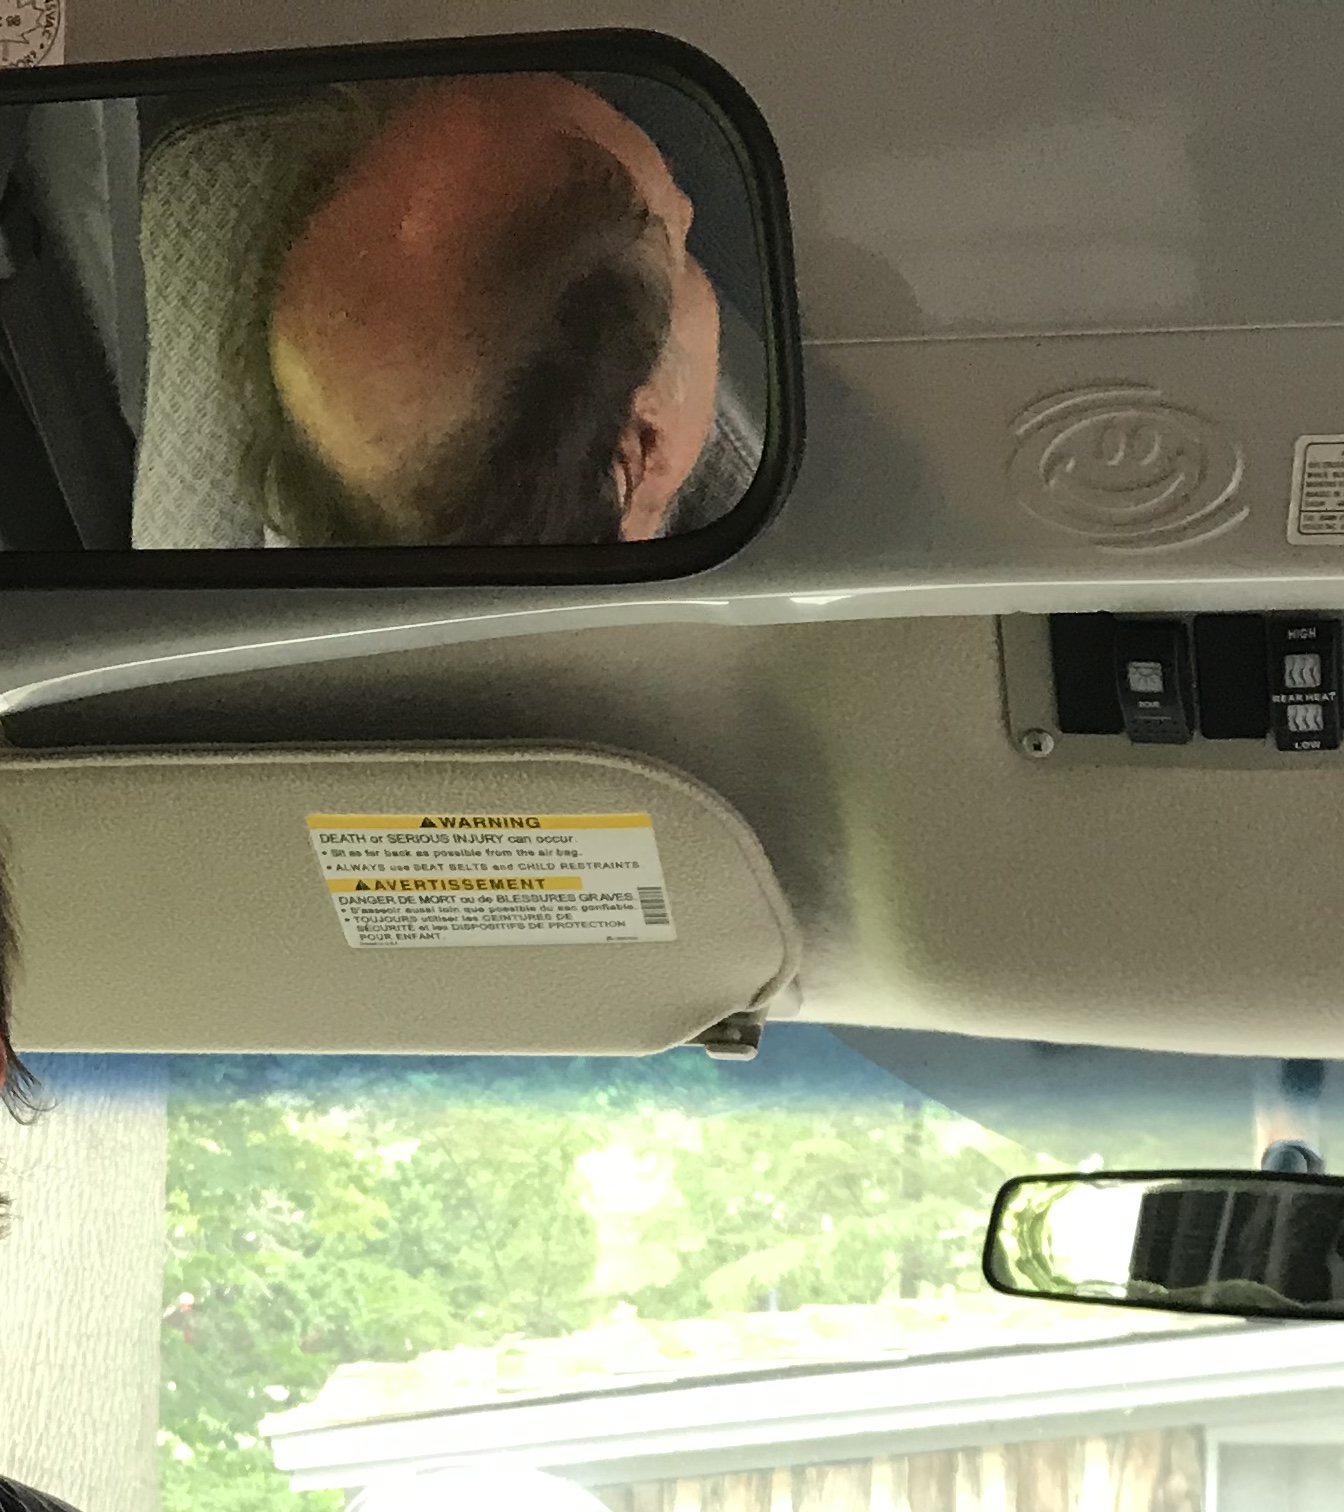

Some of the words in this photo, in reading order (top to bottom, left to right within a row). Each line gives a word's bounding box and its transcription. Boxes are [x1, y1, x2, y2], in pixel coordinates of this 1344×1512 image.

[1288, 627, 1317, 641] HIGH
[1272, 693, 1304, 704] REAR
[1306, 691, 1337, 702] HEAT
[1294, 740, 1322, 750] LOW
[438, 816, 541, 829] WARNING
[319, 834, 366, 844] DEATH
[370, 836, 383, 844] or
[386, 834, 450, 844] SERIOUS
[453, 834, 503, 844] INJURY
[508, 835, 532, 844] can
[434, 849, 482, 858] possible
[485, 849, 512, 857] from
[516, 849, 535, 857] the
[336, 863, 385, 872] ALWAYS
[413, 864, 444, 872] SEAT
[449, 863, 488, 871] BELTS
[517, 863, 556, 871] CHILD
[374, 879, 546, 891] AVERTISSEMENT
[338, 896, 396, 905] DANGER
[397, 896, 417, 905] DE
[419, 895, 457, 904] MORT
[460, 896, 475, 904] ou
[496, 893, 577, 903] BLESSURES
[548, 920, 626, 929] PROTECTION
[359, 932, 392, 941] POUR
